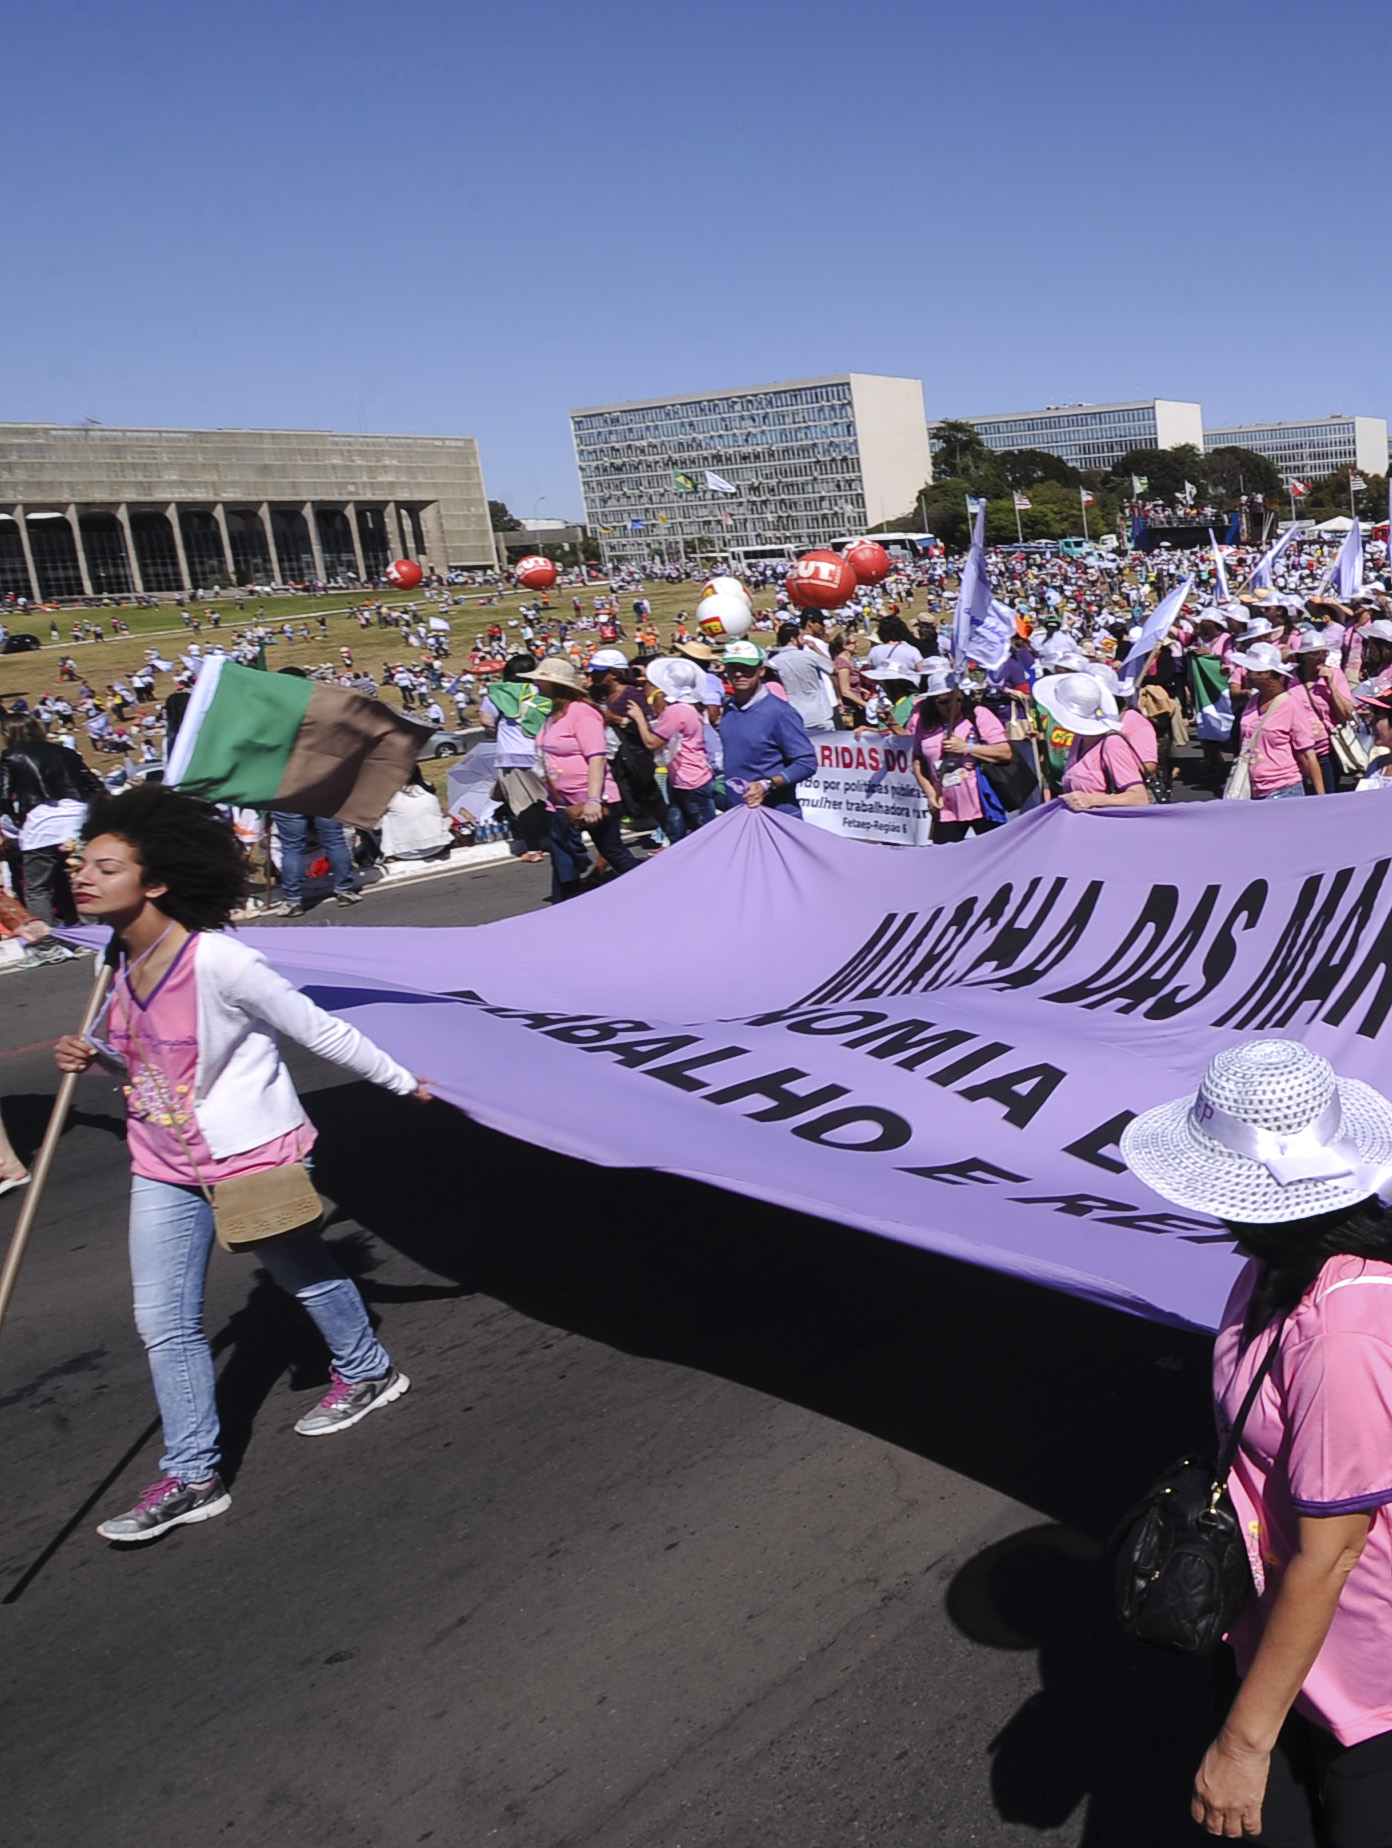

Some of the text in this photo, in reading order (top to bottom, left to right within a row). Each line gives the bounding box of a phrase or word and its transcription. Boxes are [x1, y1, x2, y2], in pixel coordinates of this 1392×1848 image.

[883, 748, 908, 773] DO
[822, 780, 842, 793] por
[800, 796, 843, 810] mulher
[793, 876, 1104, 1006] MARCHA
[1038, 878, 1269, 1021] DAS
